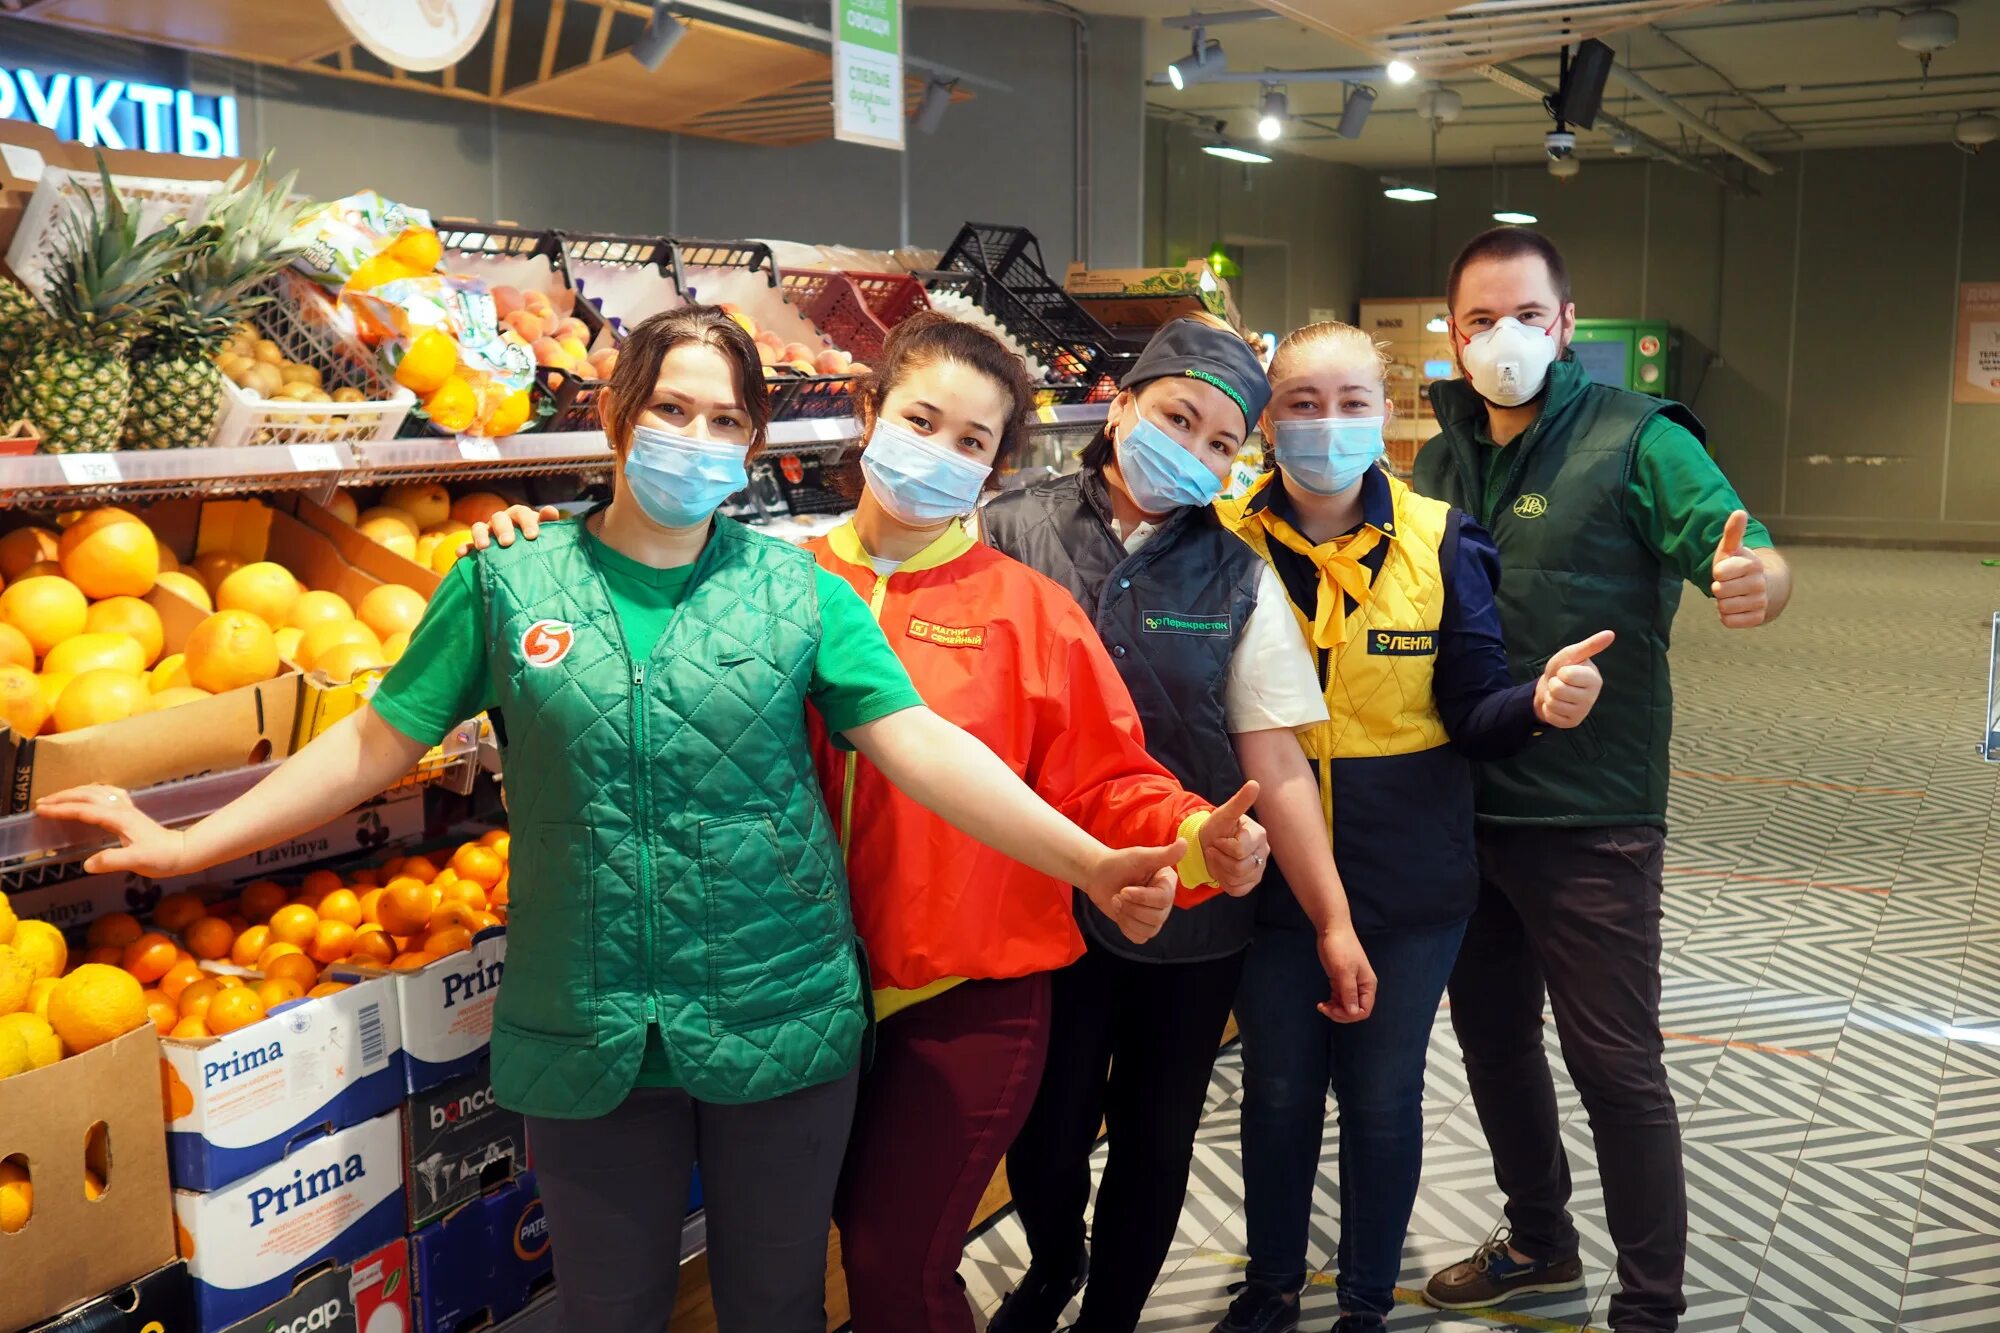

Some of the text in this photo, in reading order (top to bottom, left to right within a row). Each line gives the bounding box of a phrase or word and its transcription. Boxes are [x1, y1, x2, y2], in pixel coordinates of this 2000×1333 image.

[931, 633, 982, 645] СЕМЕЙНЫЙ
[932, 624, 970, 636] МАГНИТ
[1390, 635, 1433, 650] ЛЕНТА
[14, 765, 32, 800] BASE
[255, 838, 328, 867] Lavinya
[204, 1041, 284, 1088] Prima
[247, 1154, 366, 1228] Prima
